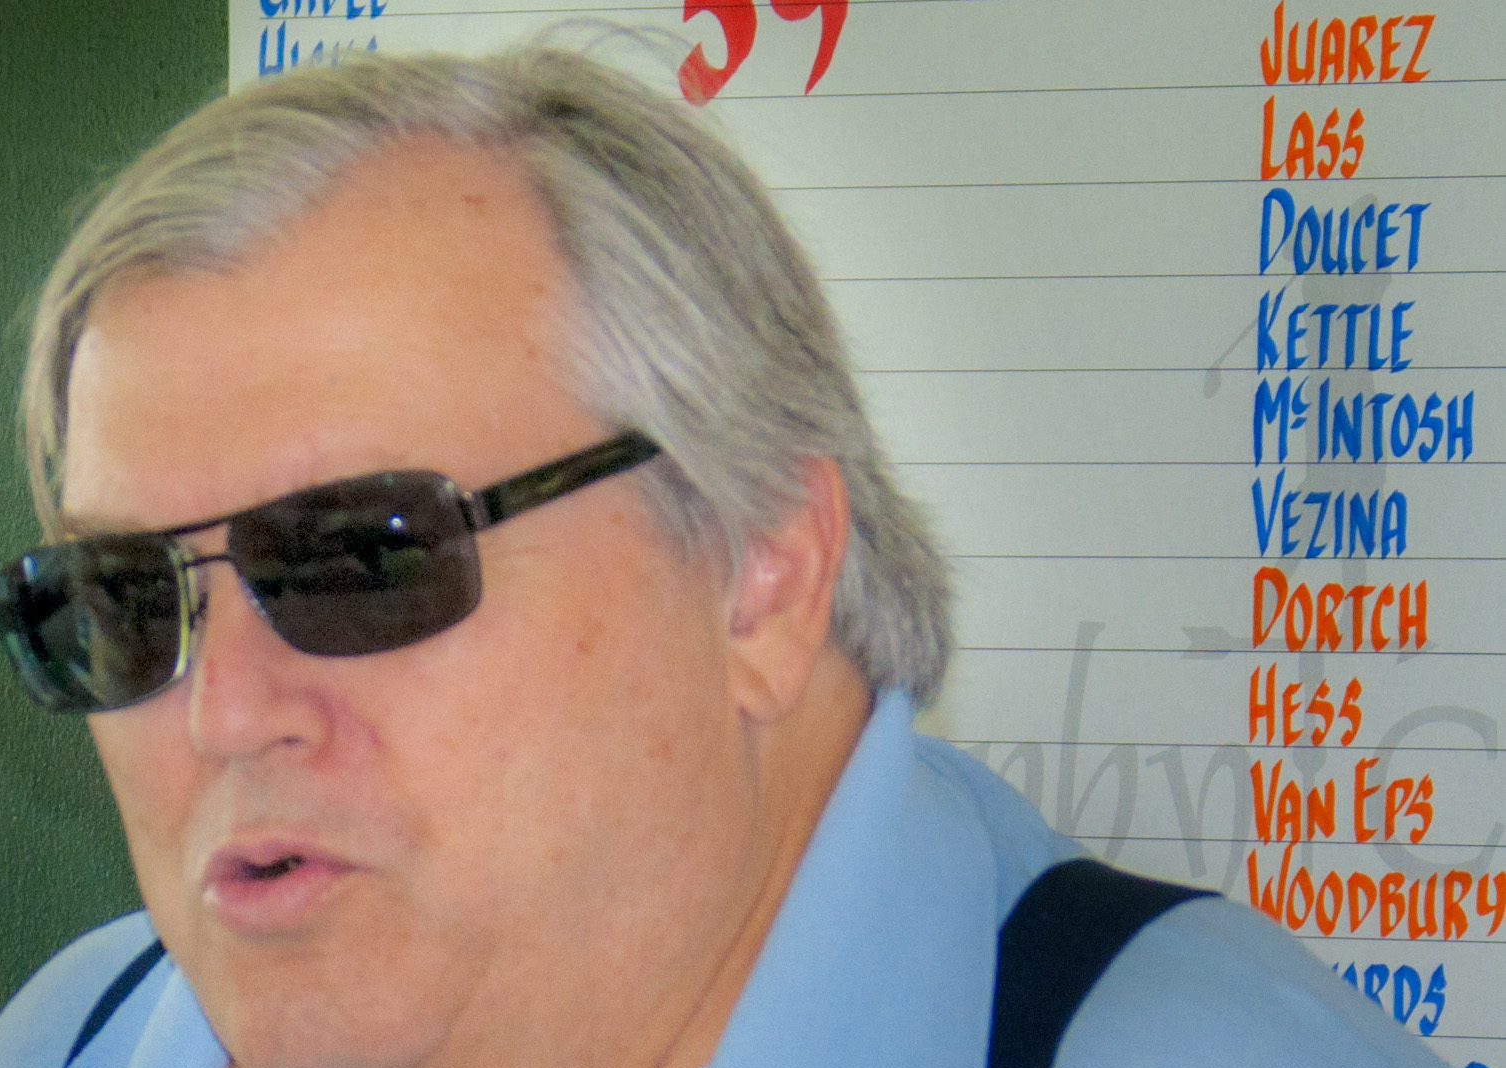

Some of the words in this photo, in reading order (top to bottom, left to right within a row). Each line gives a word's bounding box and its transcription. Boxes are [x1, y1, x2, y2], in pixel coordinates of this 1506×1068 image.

[1259, 0, 1436, 86] JUAREZ
[1260, 95, 1365, 181] LASS
[1258, 187, 1431, 276] DOUCET
[1255, 286, 1416, 374] KETTLE
[1251, 467, 1408, 560] VEZINA
[1252, 566, 1428, 652] DORTCH
[1248, 662, 1363, 748] HESS
[1249, 758, 1335, 846] VAN
[1353, 757, 1434, 845] EPS
[1246, 841, 1506, 941] WOODBURY
